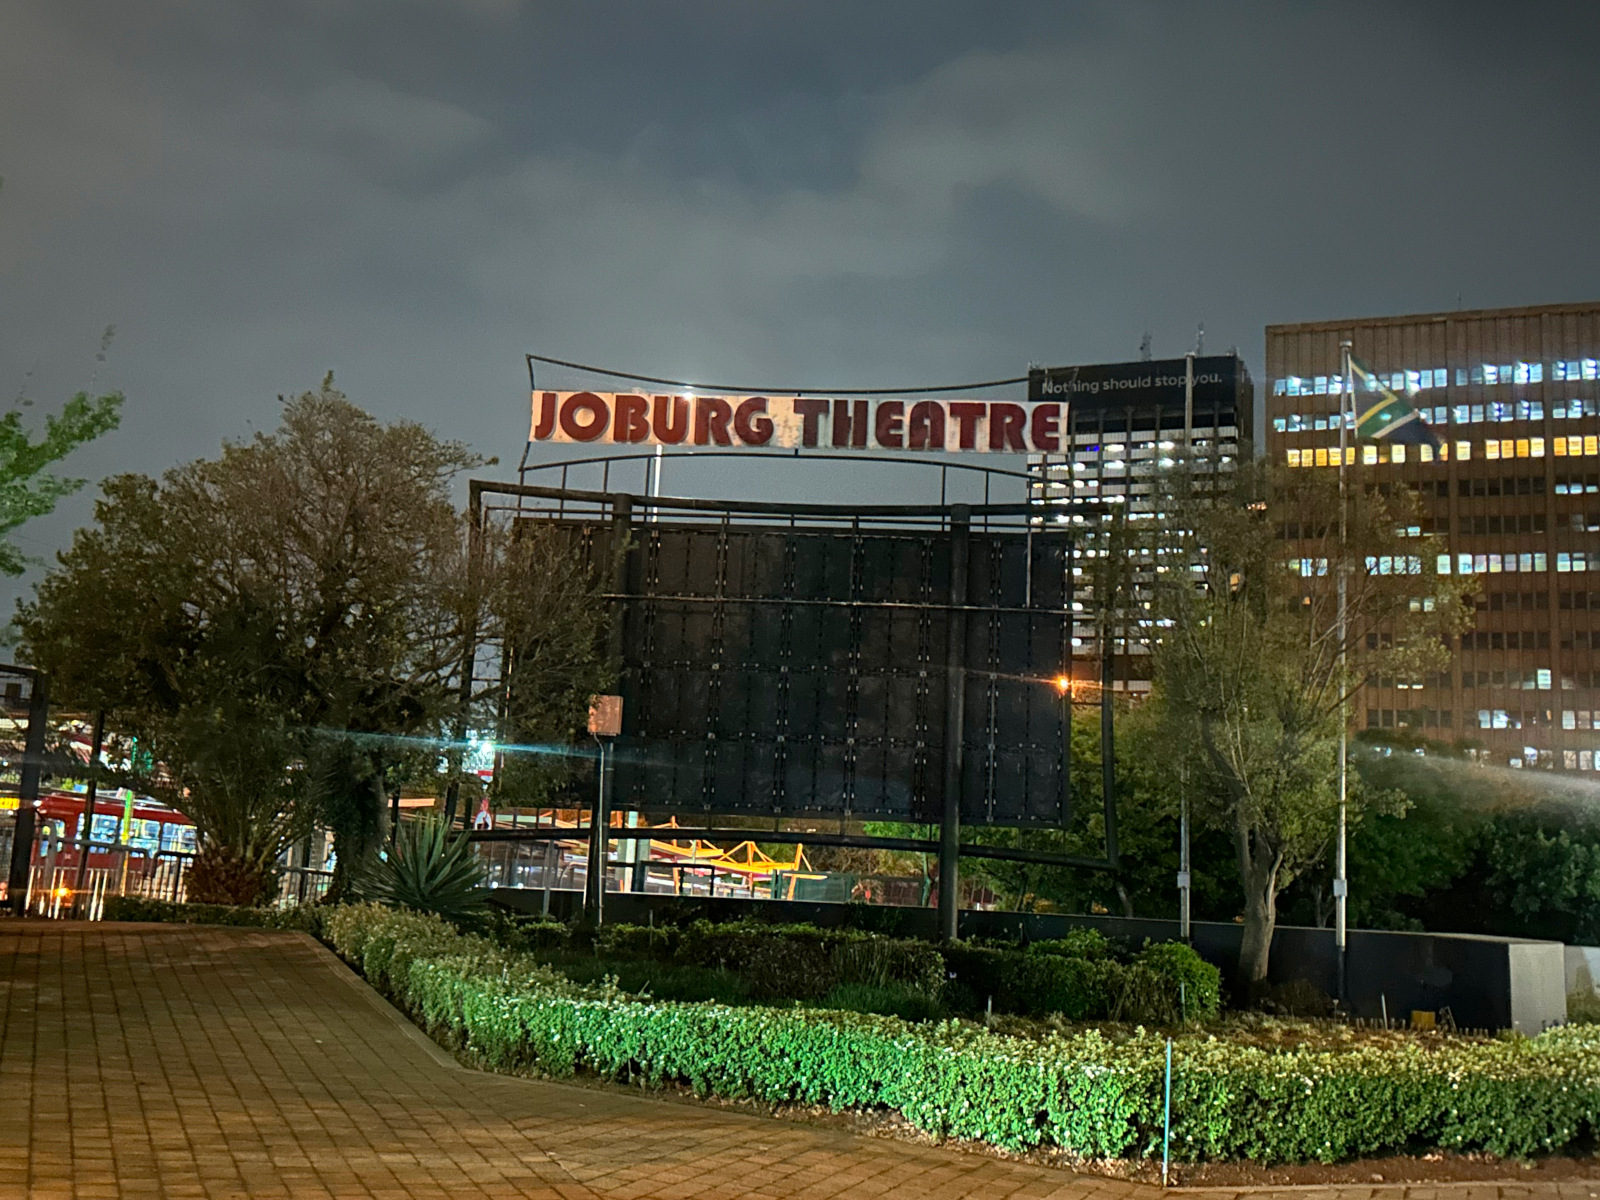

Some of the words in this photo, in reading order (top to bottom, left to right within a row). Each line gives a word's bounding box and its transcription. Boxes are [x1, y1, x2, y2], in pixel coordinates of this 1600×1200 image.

[1042, 380, 1100, 394] Nothing
[1102, 376, 1152, 390] should
[1154, 374, 1187, 388] stop
[1190, 373, 1222, 387] you.
[535, 392, 774, 447] JOBURG
[794, 399, 1061, 451] THEATRE
